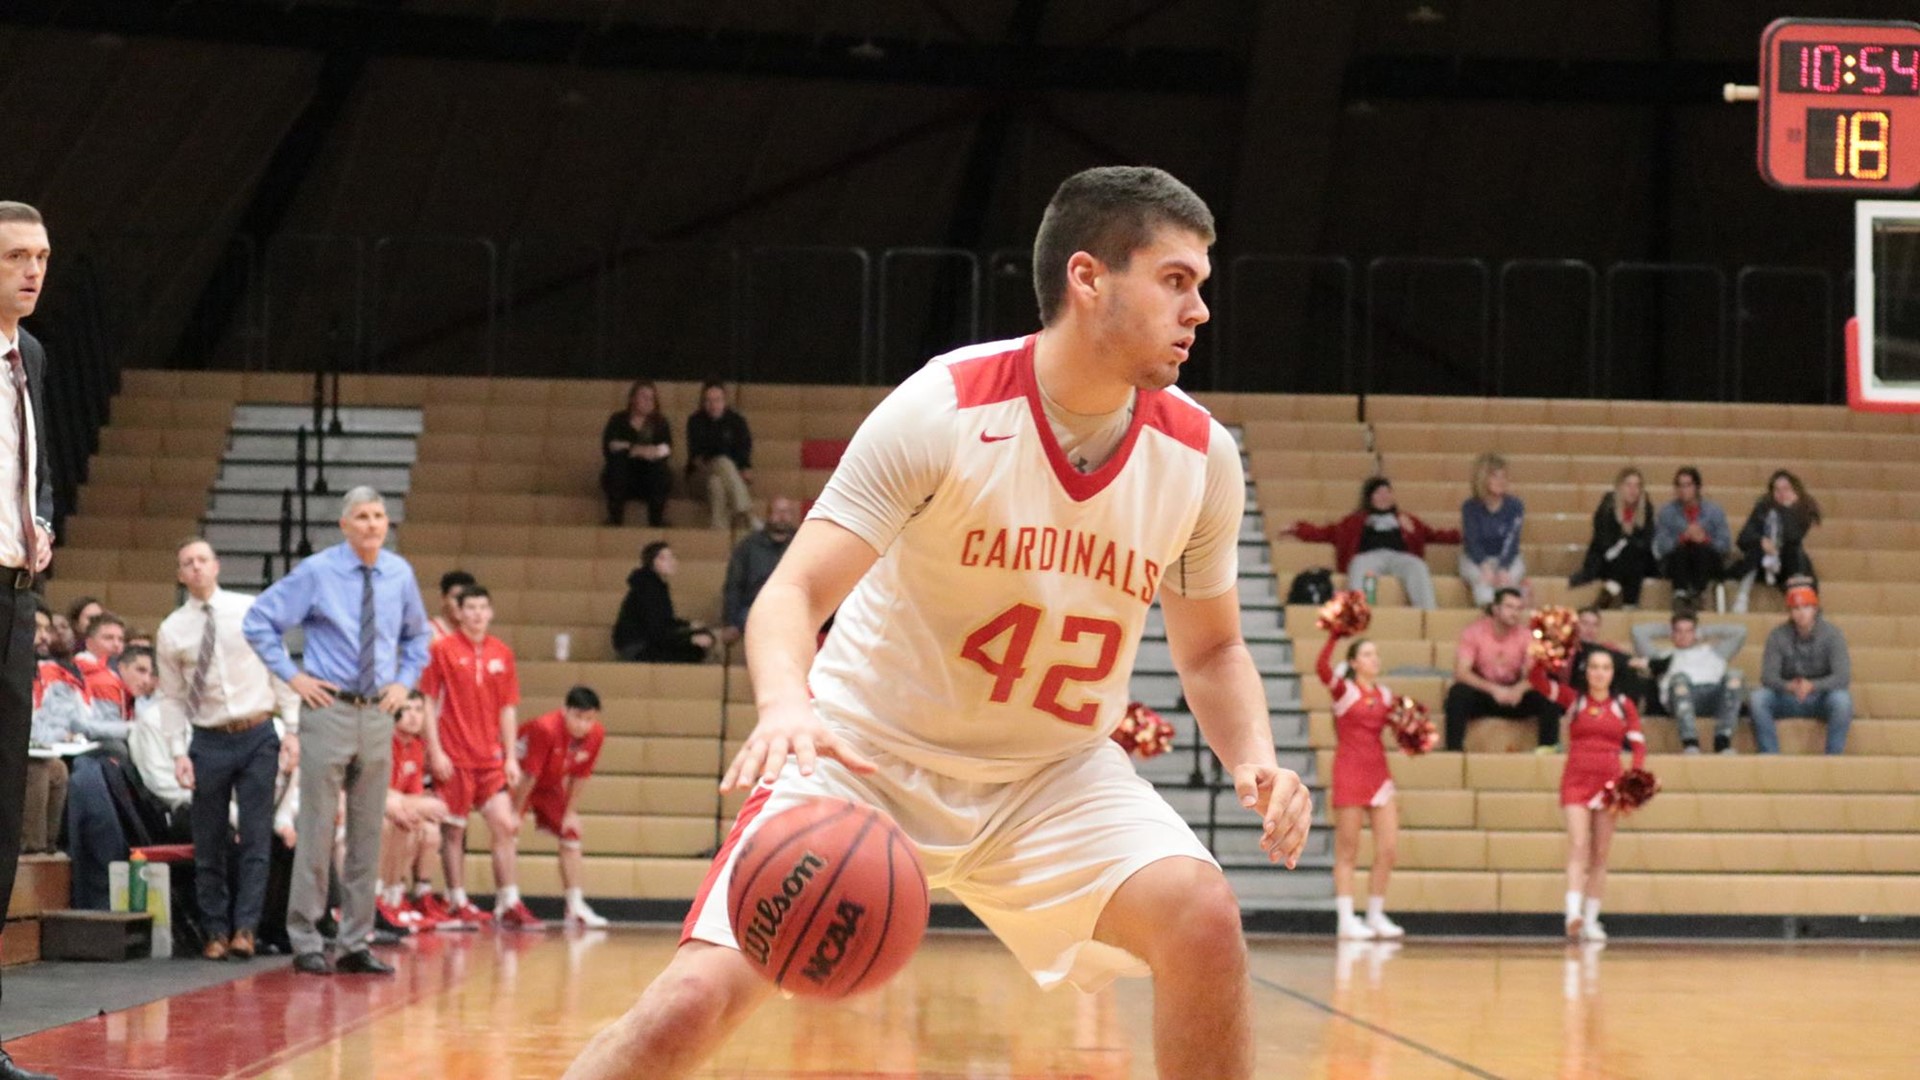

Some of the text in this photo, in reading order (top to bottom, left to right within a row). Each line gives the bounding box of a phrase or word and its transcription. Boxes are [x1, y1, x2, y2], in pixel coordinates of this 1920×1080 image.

[1800, 45, 1919, 93] 10:54
[1835, 111, 1889, 180] 18
[960, 527, 1159, 605] CARDINALS
[959, 601, 1123, 728] 42
[745, 851, 827, 967] Wilson
[802, 898, 865, 985] NCAA
